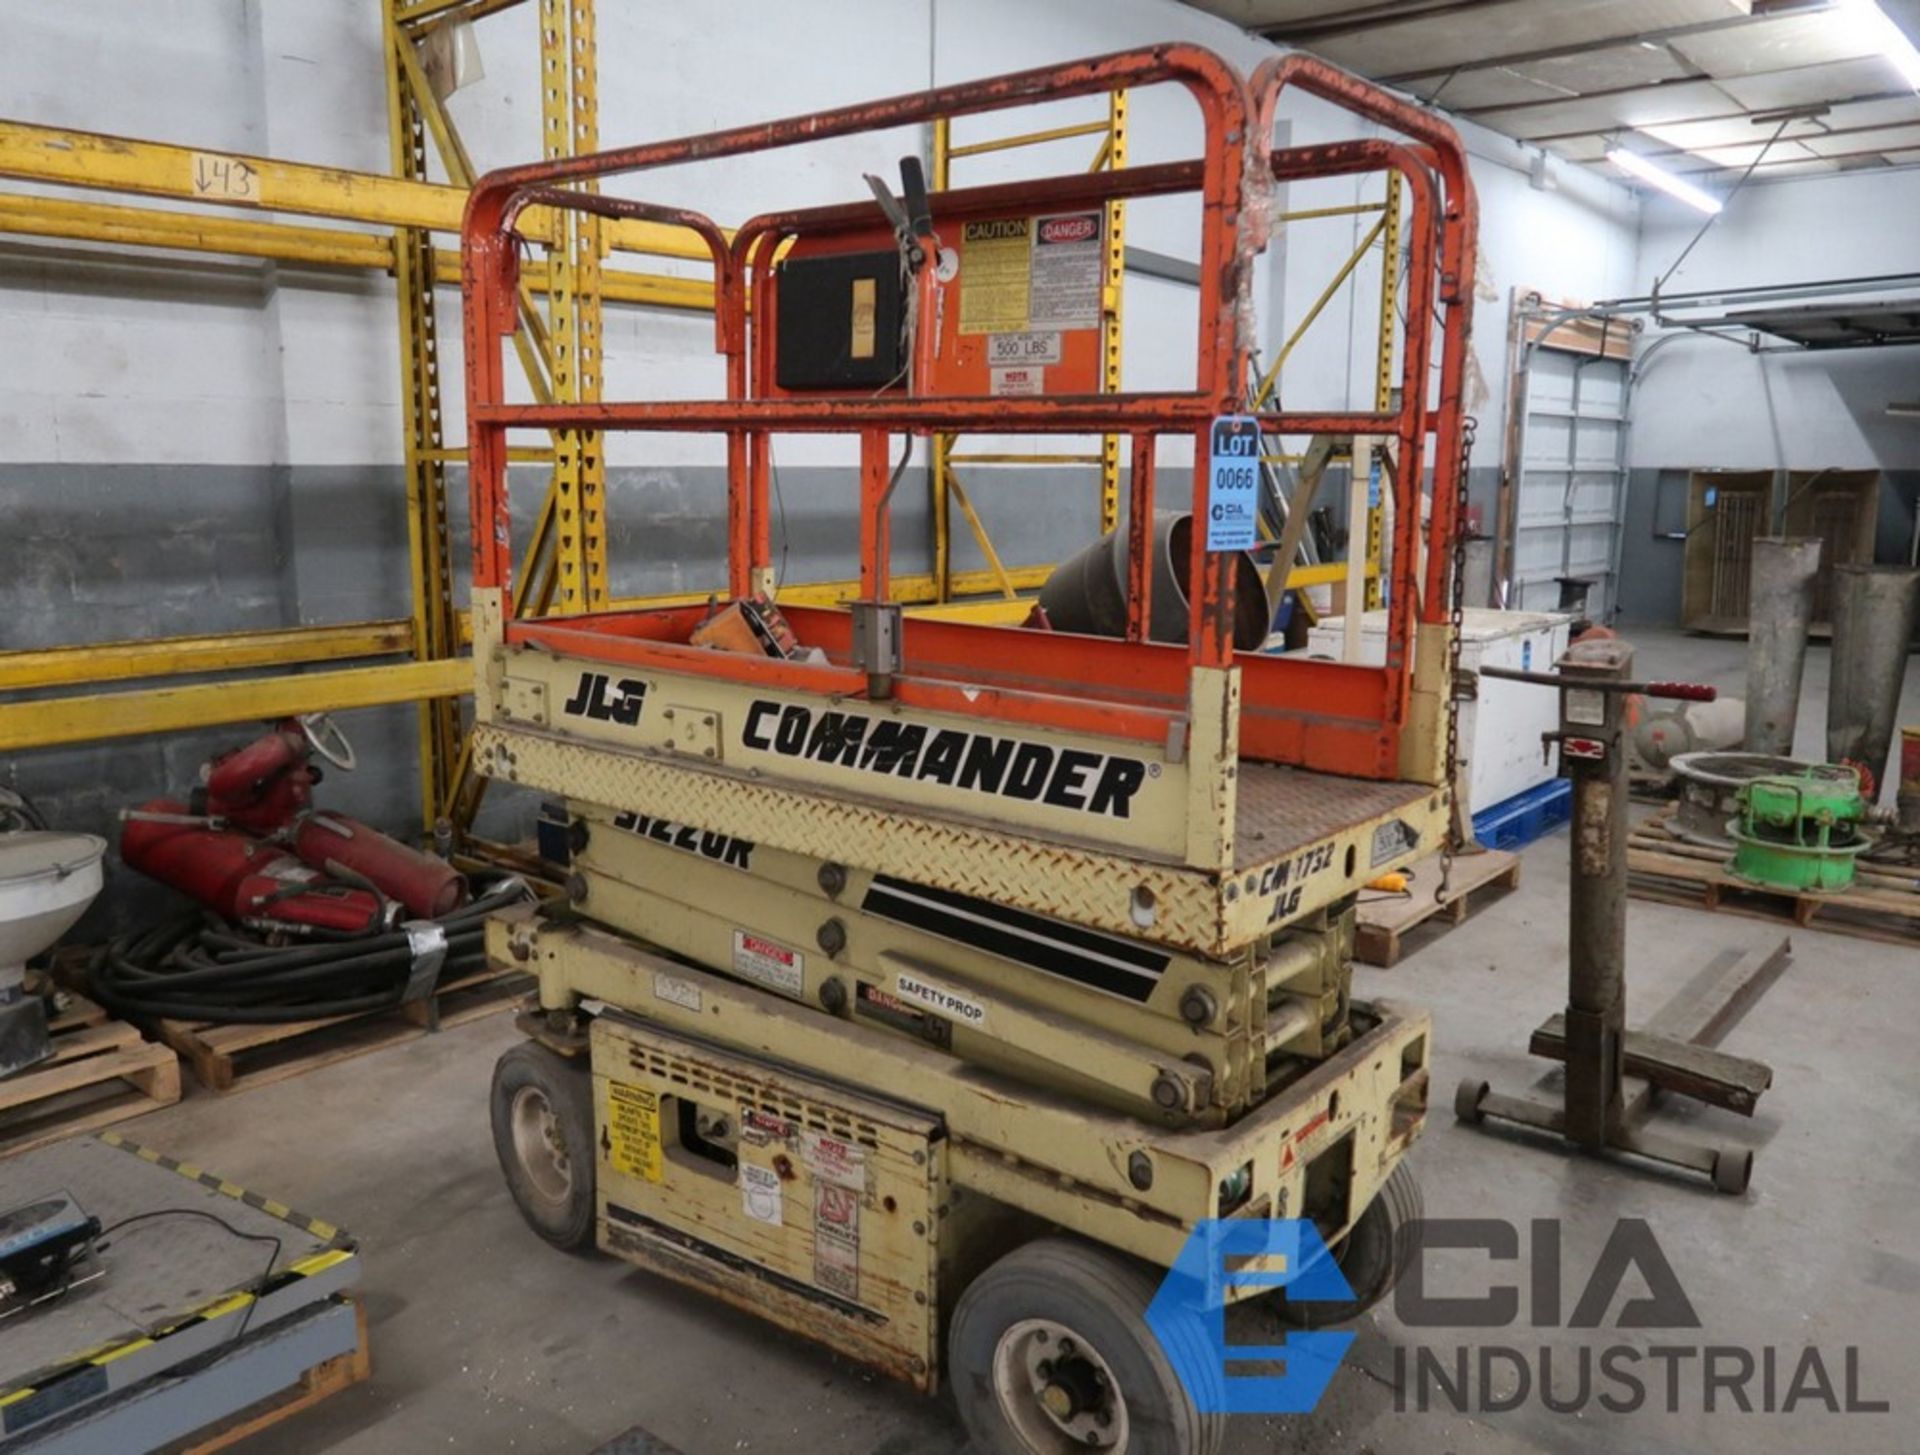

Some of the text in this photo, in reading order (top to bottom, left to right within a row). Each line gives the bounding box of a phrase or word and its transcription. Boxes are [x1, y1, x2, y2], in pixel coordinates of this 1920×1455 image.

[213, 161, 253, 195] 43
[966, 220, 1027, 240] CAUTION
[1045, 219, 1093, 238] DANGER
[997, 340, 1047, 356] 500 LBS
[1219, 434, 1253, 455] LOT
[1216, 467, 1253, 489] 0066
[564, 672, 647, 727] JLG
[1267, 885, 1303, 926] JLG
[898, 977, 983, 1021] SAFETY PROP
